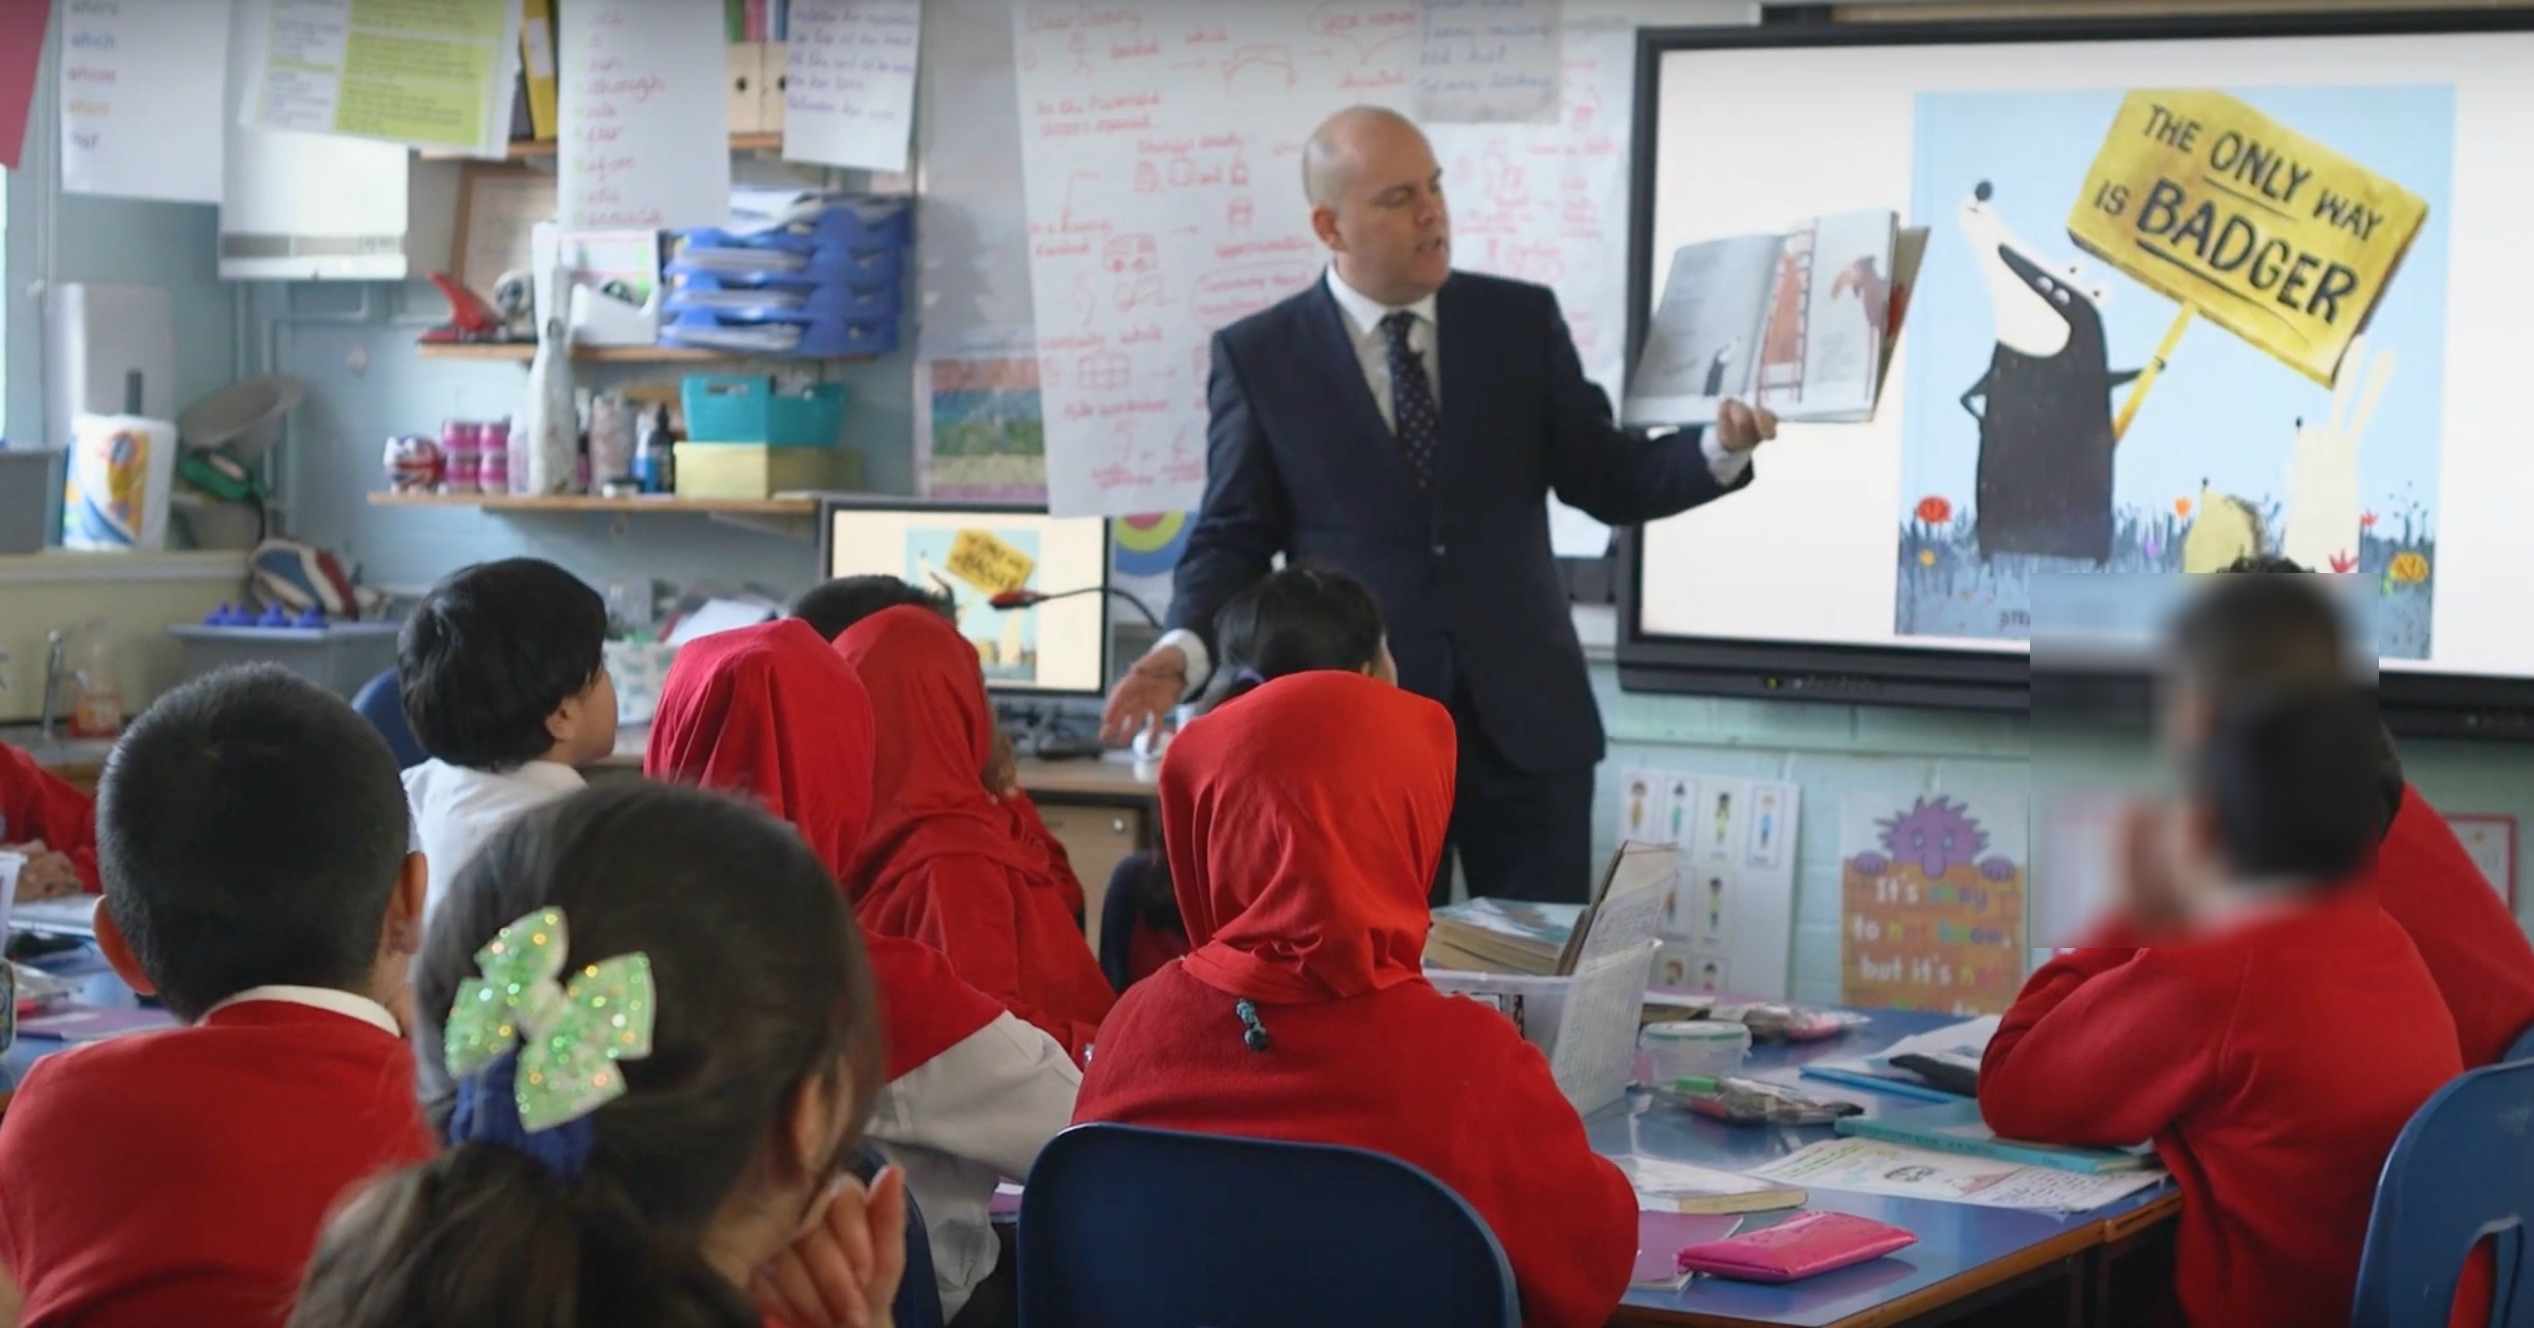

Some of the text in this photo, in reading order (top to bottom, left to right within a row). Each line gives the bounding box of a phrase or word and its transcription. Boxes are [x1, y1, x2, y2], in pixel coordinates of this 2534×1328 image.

[2142, 102, 2385, 242] THE ONLY WAY
[2094, 179, 2360, 326] IS BADGER
[1876, 871, 1919, 904] It's
[1853, 913, 1880, 940] to
[1860, 953, 1902, 981] but
[1911, 954, 1952, 985] it's
